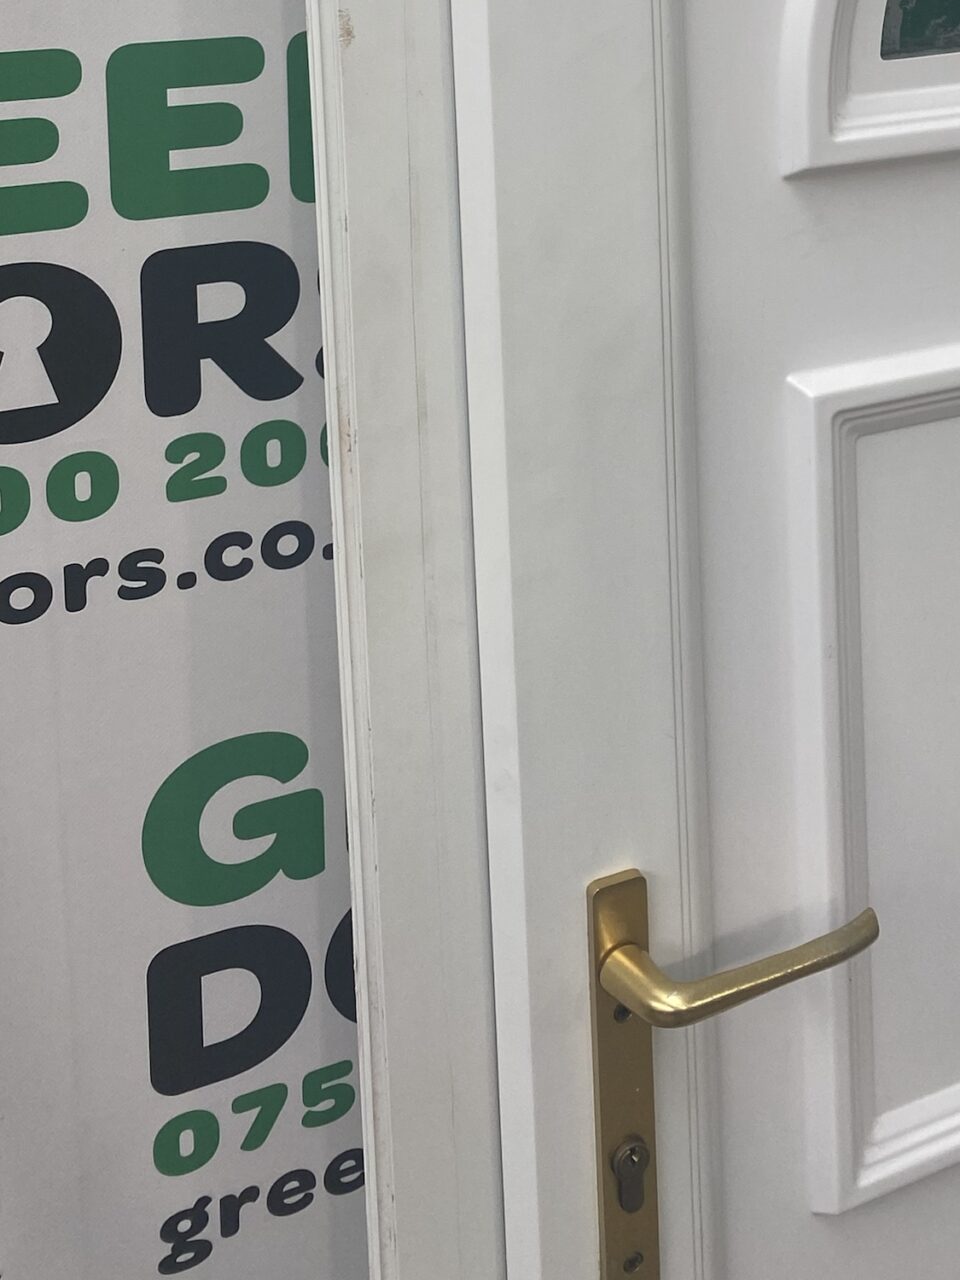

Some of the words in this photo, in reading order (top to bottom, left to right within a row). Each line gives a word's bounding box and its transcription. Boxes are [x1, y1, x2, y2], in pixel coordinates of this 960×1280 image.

[0, 31, 315, 235] EE
[164, 419, 329, 503] 20
[153, 1059, 356, 1176] 075
[157, 1148, 366, 1275] gree
